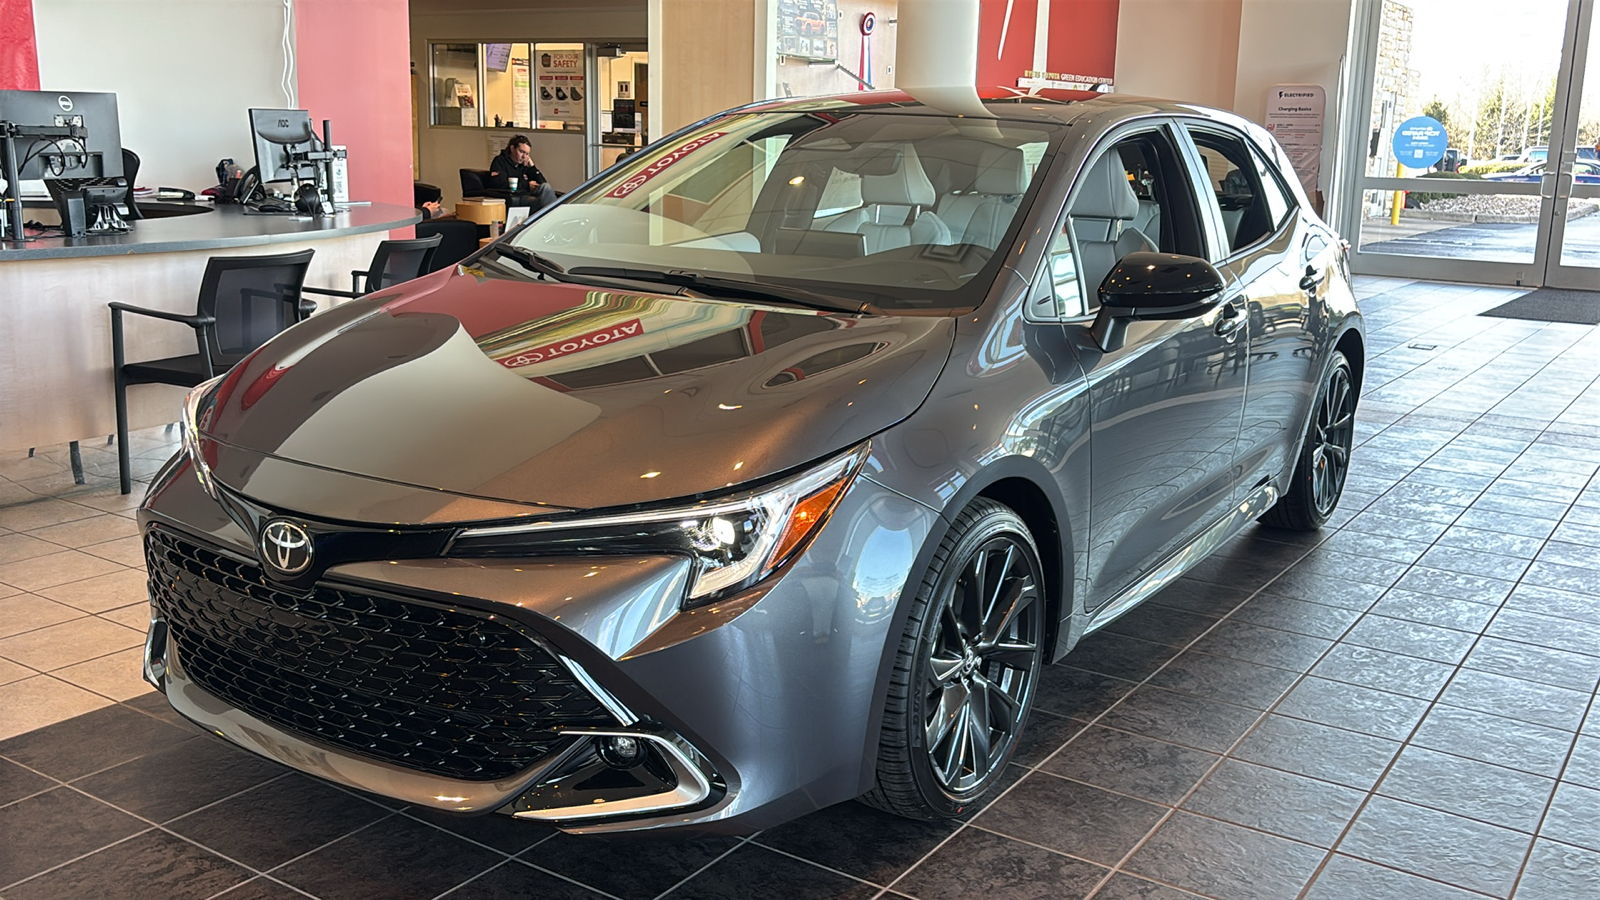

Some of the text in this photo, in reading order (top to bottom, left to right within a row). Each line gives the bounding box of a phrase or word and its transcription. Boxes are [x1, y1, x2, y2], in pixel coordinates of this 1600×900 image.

[553, 60, 578, 68] SAFETY
[1060, 73, 1075, 82] GREEN
[1075, 74, 1098, 84] EDUCATION
[1098, 77, 1113, 85] CENTER
